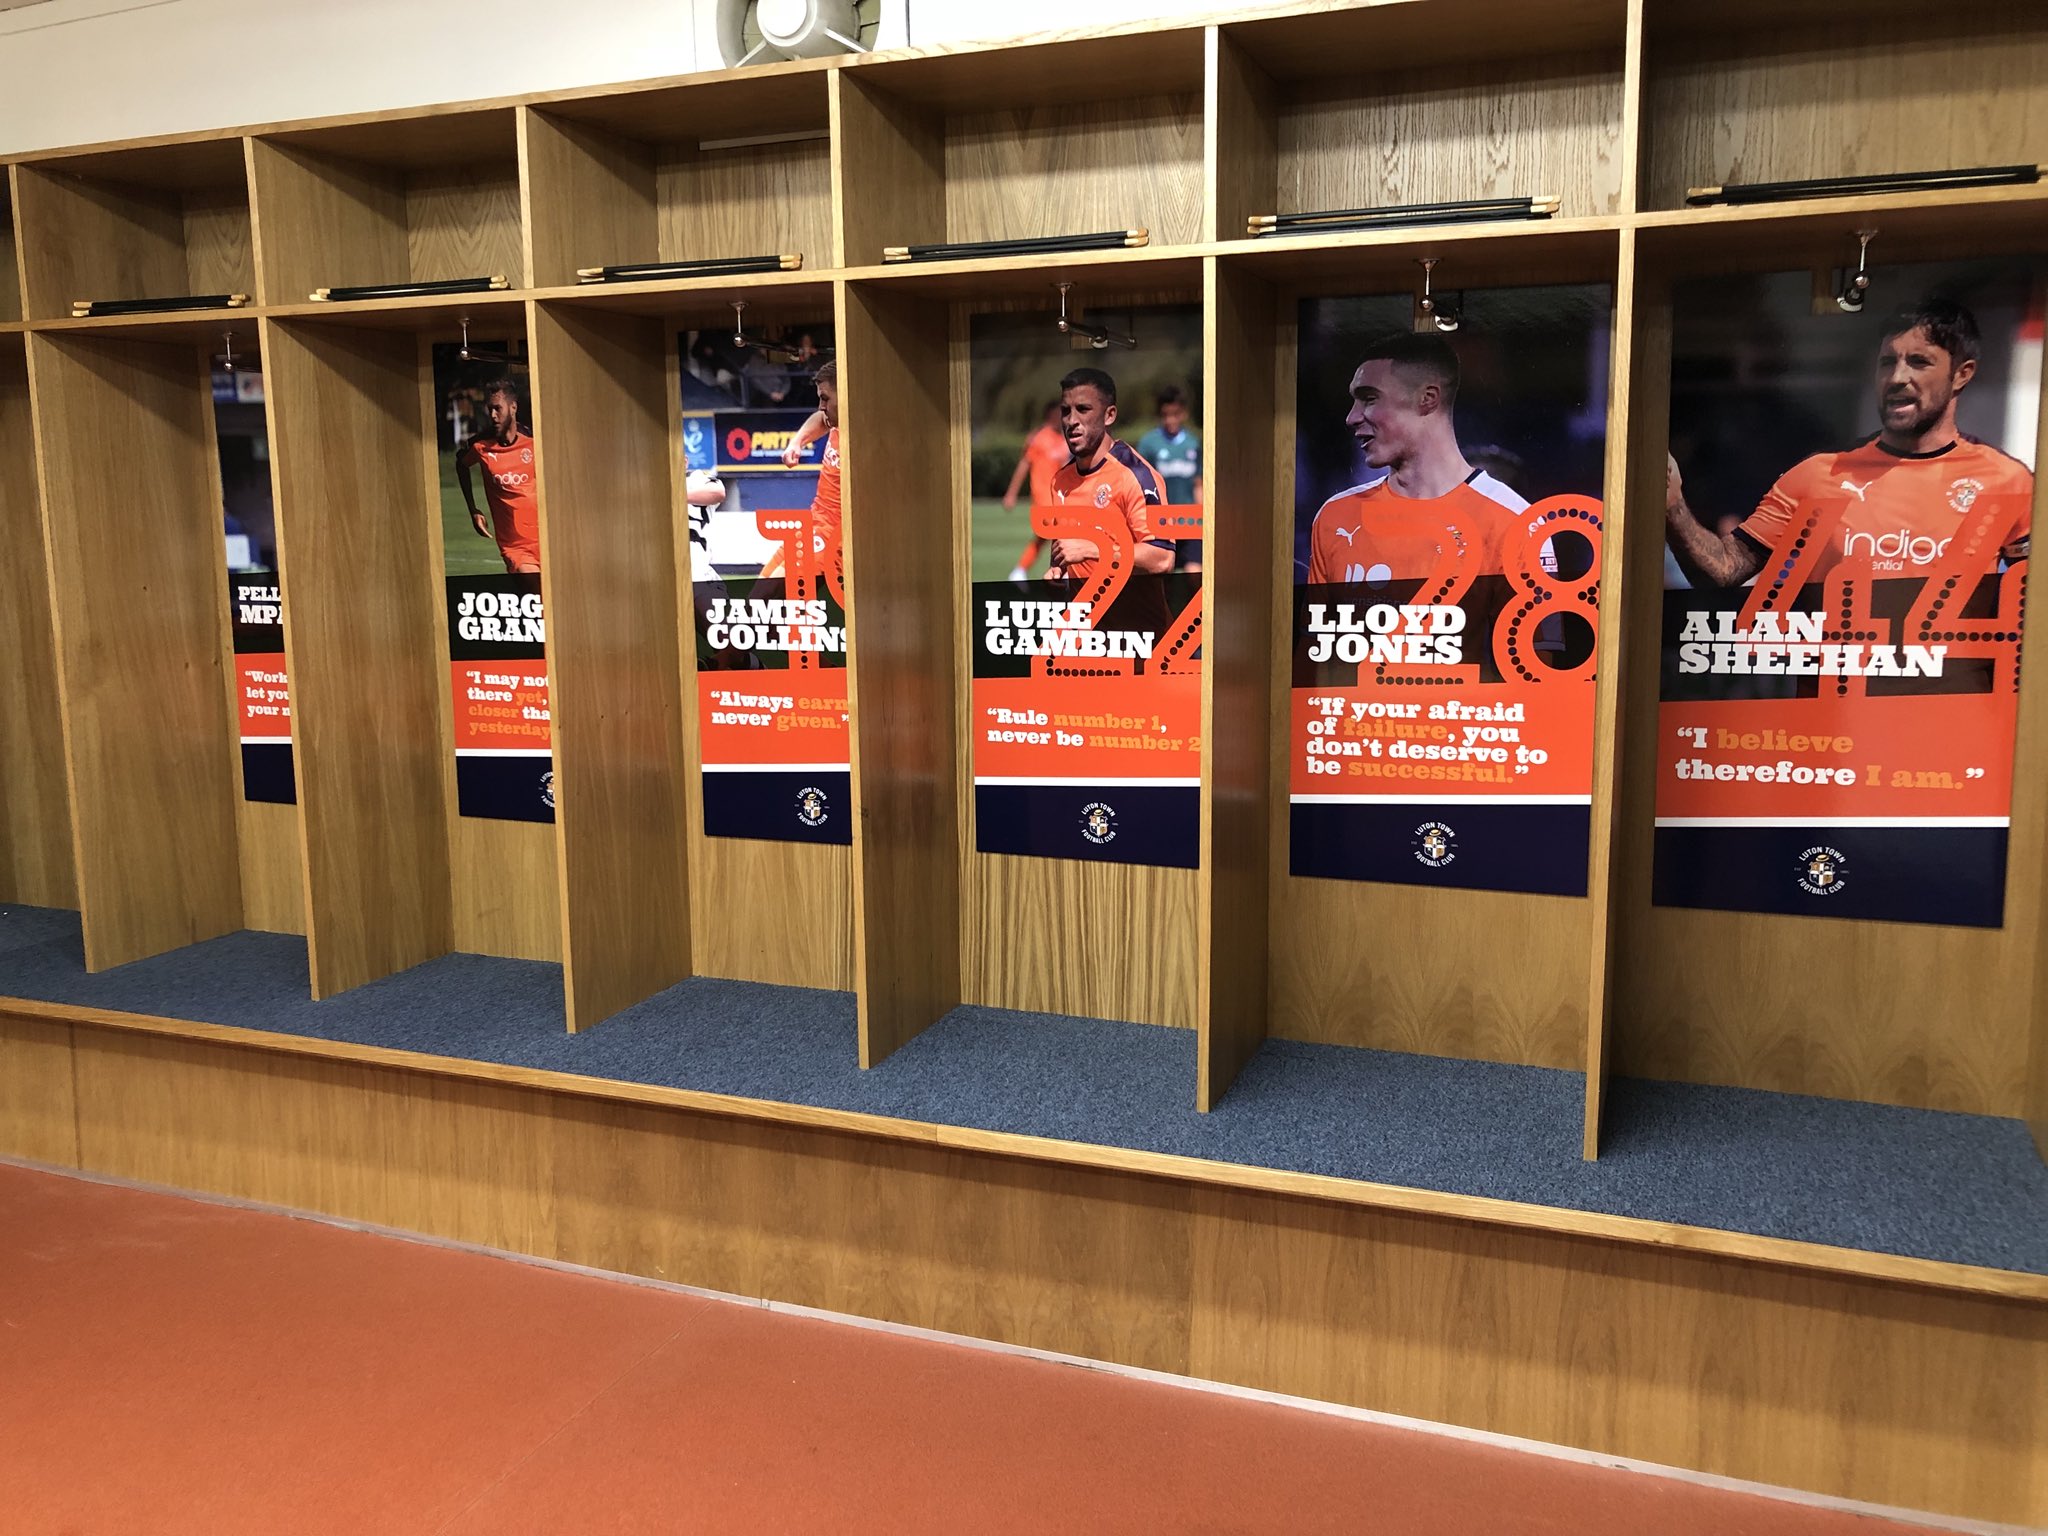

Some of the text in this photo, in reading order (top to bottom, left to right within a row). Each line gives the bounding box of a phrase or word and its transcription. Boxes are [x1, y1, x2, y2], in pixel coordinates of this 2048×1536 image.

[457, 592, 544, 618] JORG
[706, 598, 827, 626] JAMES
[985, 601, 1092, 630] LUKE
[1308, 604, 1466, 635] LLOYD
[1679, 611, 1827, 642] ALAN
[985, 628, 1155, 659] GAMBIN
[1308, 633, 1463, 665] JONES
[1679, 642, 1948, 677] SHEEHAN
[484, 674, 520, 689] may
[246, 687, 265, 699] let
[467, 687, 547, 706] there yet,
[711, 691, 848, 713] “Always earn
[247, 705, 279, 717] your
[468, 704, 519, 718] closer
[712, 712, 772, 727] never
[987, 708, 1048, 726] “Rule
[1053, 713, 1145, 731] number
[1351, 702, 1422, 722] your
[1428, 700, 1525, 722] afraid
[470, 722, 551, 740] yesterday
[987, 729, 1051, 745] never
[1056, 731, 1084, 747] be
[1089, 734, 1183, 752] number
[1306, 715, 1520, 747] of failure, you
[1716, 728, 1853, 753] believe
[1306, 737, 1548, 764] don’t deserve to
[1306, 756, 1341, 775] be
[1675, 758, 1857, 786] therefore
[1865, 764, 1881, 786] I
[1081, 802, 1116, 817] LUTON TOWN
[1081, 828, 1117, 844] FOOTBALL CLUB
[1414, 822, 1456, 838] LUTON TOWN
[1414, 850, 1456, 867] FOOTBALL CLUB
[1798, 846, 1846, 863] LUTON TOWN
[1797, 877, 1845, 895] FOOTBALL CLUB
